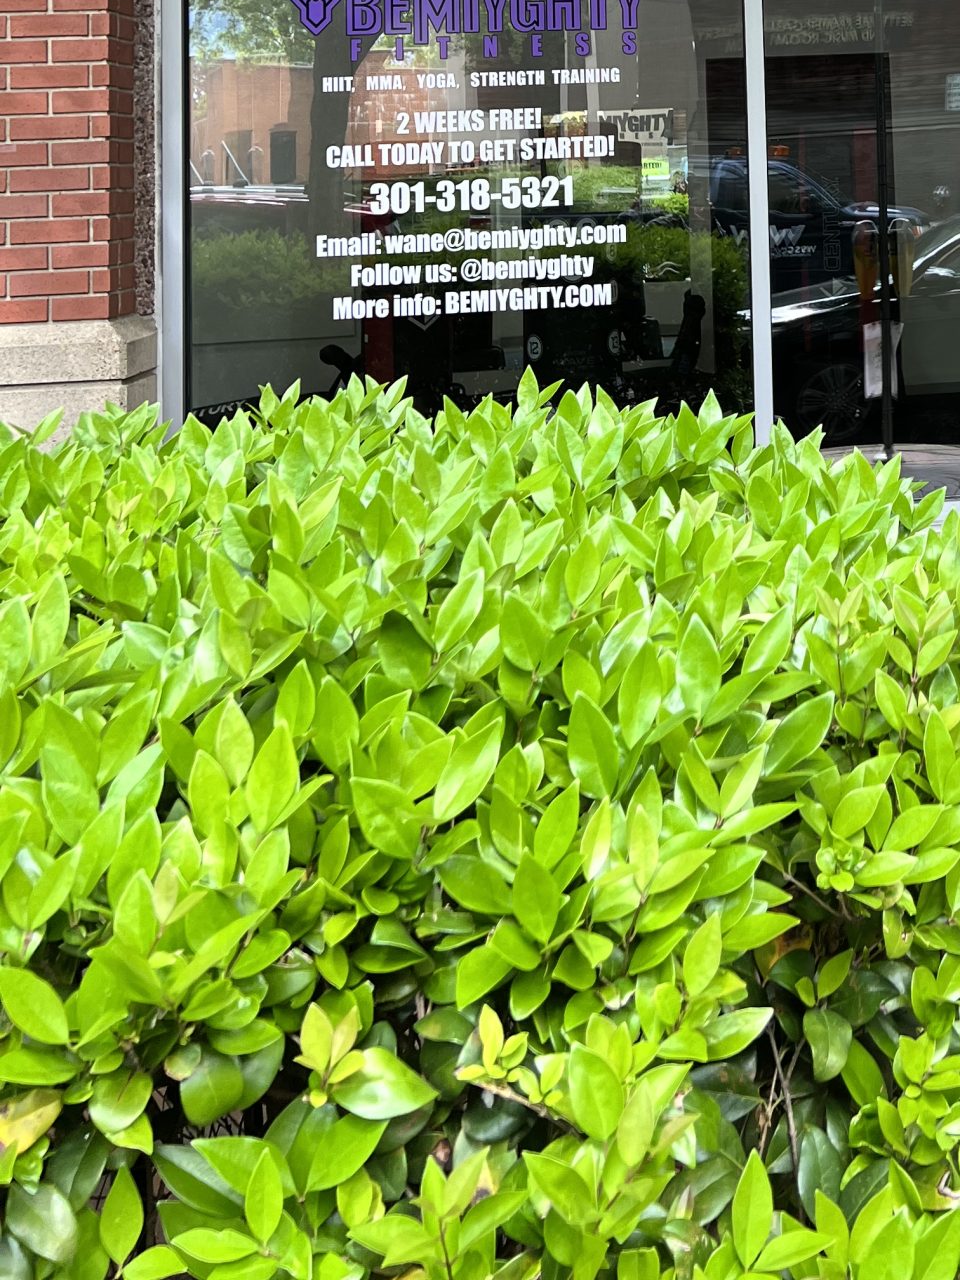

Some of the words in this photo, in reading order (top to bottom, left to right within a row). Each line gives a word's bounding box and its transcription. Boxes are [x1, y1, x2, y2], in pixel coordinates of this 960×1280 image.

[349, 30, 638, 62] FITNESS
[322, 76, 355, 93] HIIT,
[366, 74, 406, 91] MMA,
[416, 72, 460, 90] YOGA,
[470, 70, 545, 88] STRENGTH
[552, 67, 620, 85] TRAINING
[396, 111, 409, 135] 2
[413, 109, 485, 134] WEEKS
[489, 107, 542, 131] FREE!
[326, 144, 376, 168] CALL
[378, 141, 445, 166] TODAY
[447, 140, 475, 163] TO
[479, 138, 516, 162] GET
[520, 135, 615, 161] STARTED!
[369, 175, 574, 215] 301-318-5321
[822, 175, 841, 272] CENTUY
[316, 233, 382, 258] Email:
[384, 223, 627, 255] wane@bemiyghty.com
[350, 263, 422, 287] Follow
[424, 263, 458, 284] us:
[460, 254, 595, 282] @bemiyghty
[333, 297, 390, 320] More
[392, 293, 442, 317] info:
[445, 283, 612, 315] BEMIYGHTY.COM
